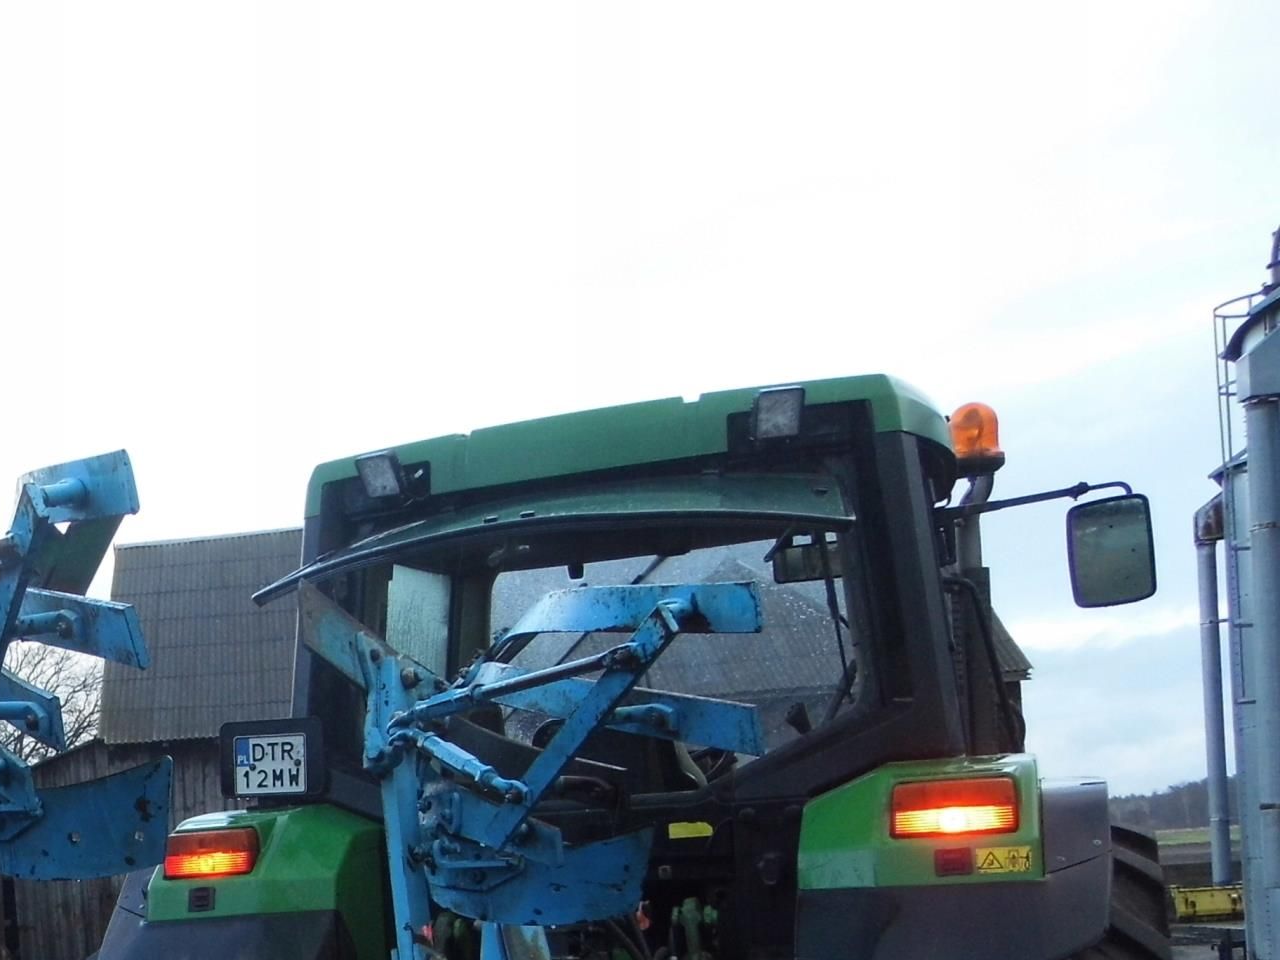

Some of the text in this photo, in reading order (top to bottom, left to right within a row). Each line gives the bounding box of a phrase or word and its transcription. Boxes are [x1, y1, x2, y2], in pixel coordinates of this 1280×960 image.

[237, 755, 249, 765] PL
[252, 741, 294, 762] DTR
[243, 767, 300, 789] 12MW
